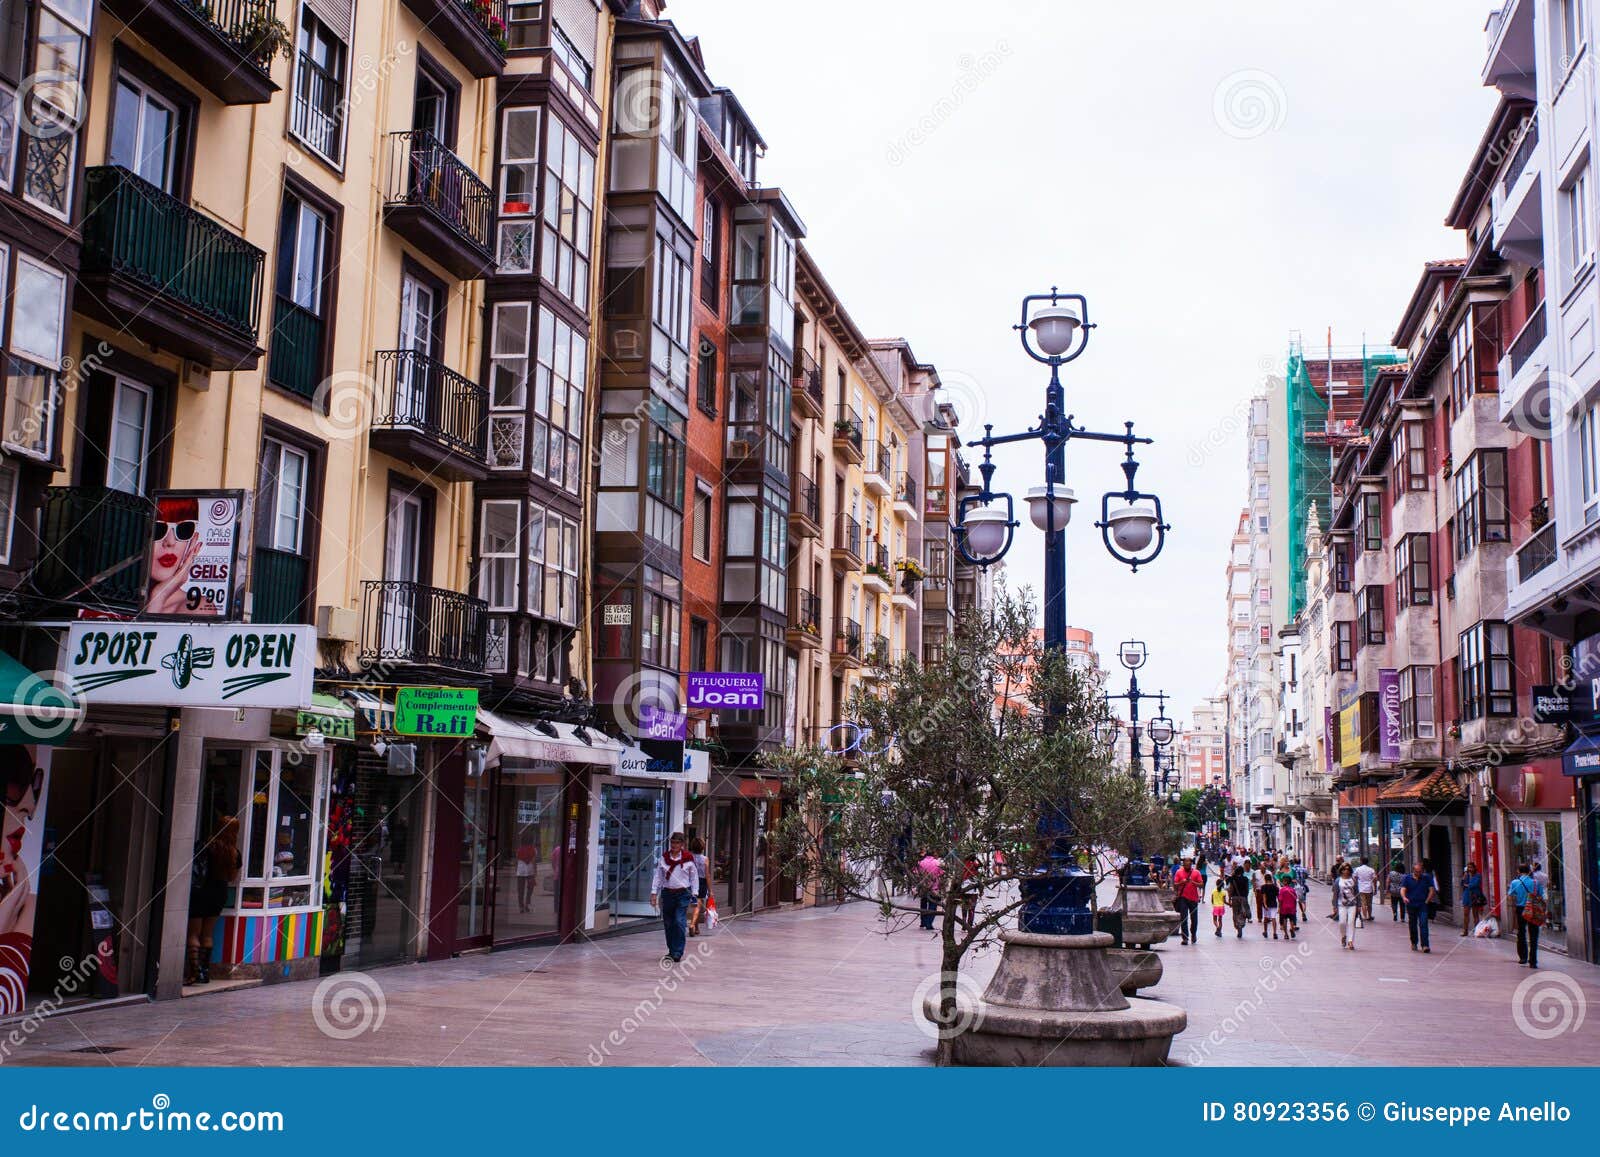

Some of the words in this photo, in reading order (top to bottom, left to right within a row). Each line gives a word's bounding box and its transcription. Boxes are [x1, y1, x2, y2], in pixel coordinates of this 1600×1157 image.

[189, 564, 228, 579] GEILS
[605, 605, 613, 613] SE
[613, 605, 631, 613] VENDE
[74, 632, 157, 667] SPORT
[225, 633, 296, 668] OPEN
[691, 677, 759, 688] PELUQUERIA
[413, 689, 453, 700] Regalos
[689, 687, 759, 705] Joan
[1537, 696, 1569, 704] Phone
[1538, 704, 1570, 712] House
[415, 713, 468, 734] Rafi
[648, 715, 675, 739] Joan
